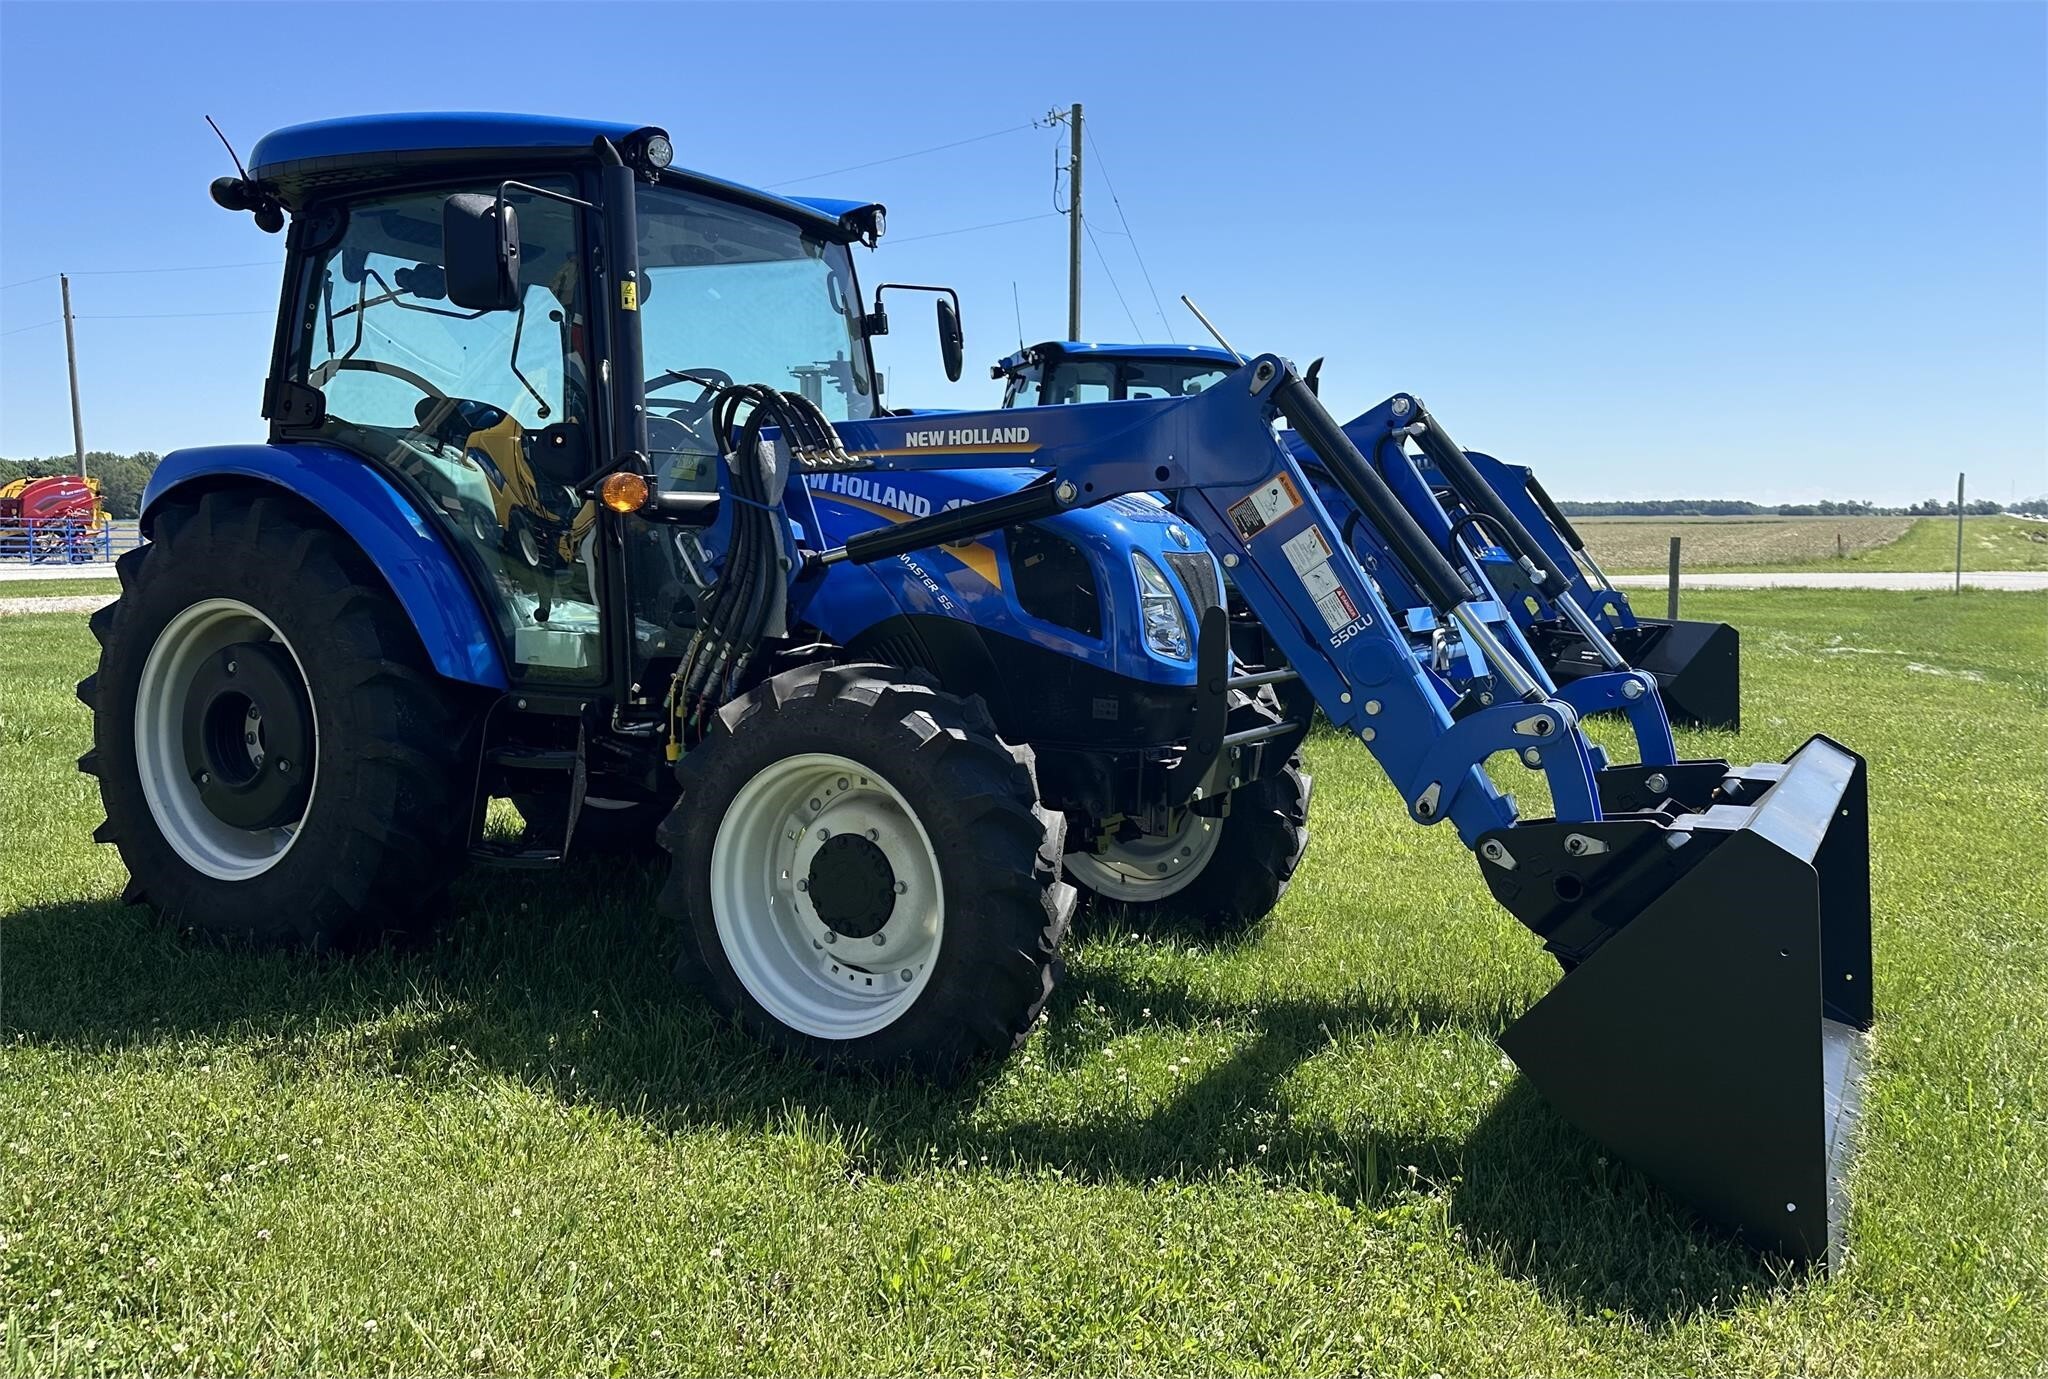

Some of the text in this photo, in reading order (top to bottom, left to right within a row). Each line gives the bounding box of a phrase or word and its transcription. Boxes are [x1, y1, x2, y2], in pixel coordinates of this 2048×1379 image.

[905, 427, 1030, 448] NEW HOLLAND
[831, 472, 931, 518] HOLLAND
[937, 594, 954, 610] 55
[1329, 613, 1374, 649] 550LU
